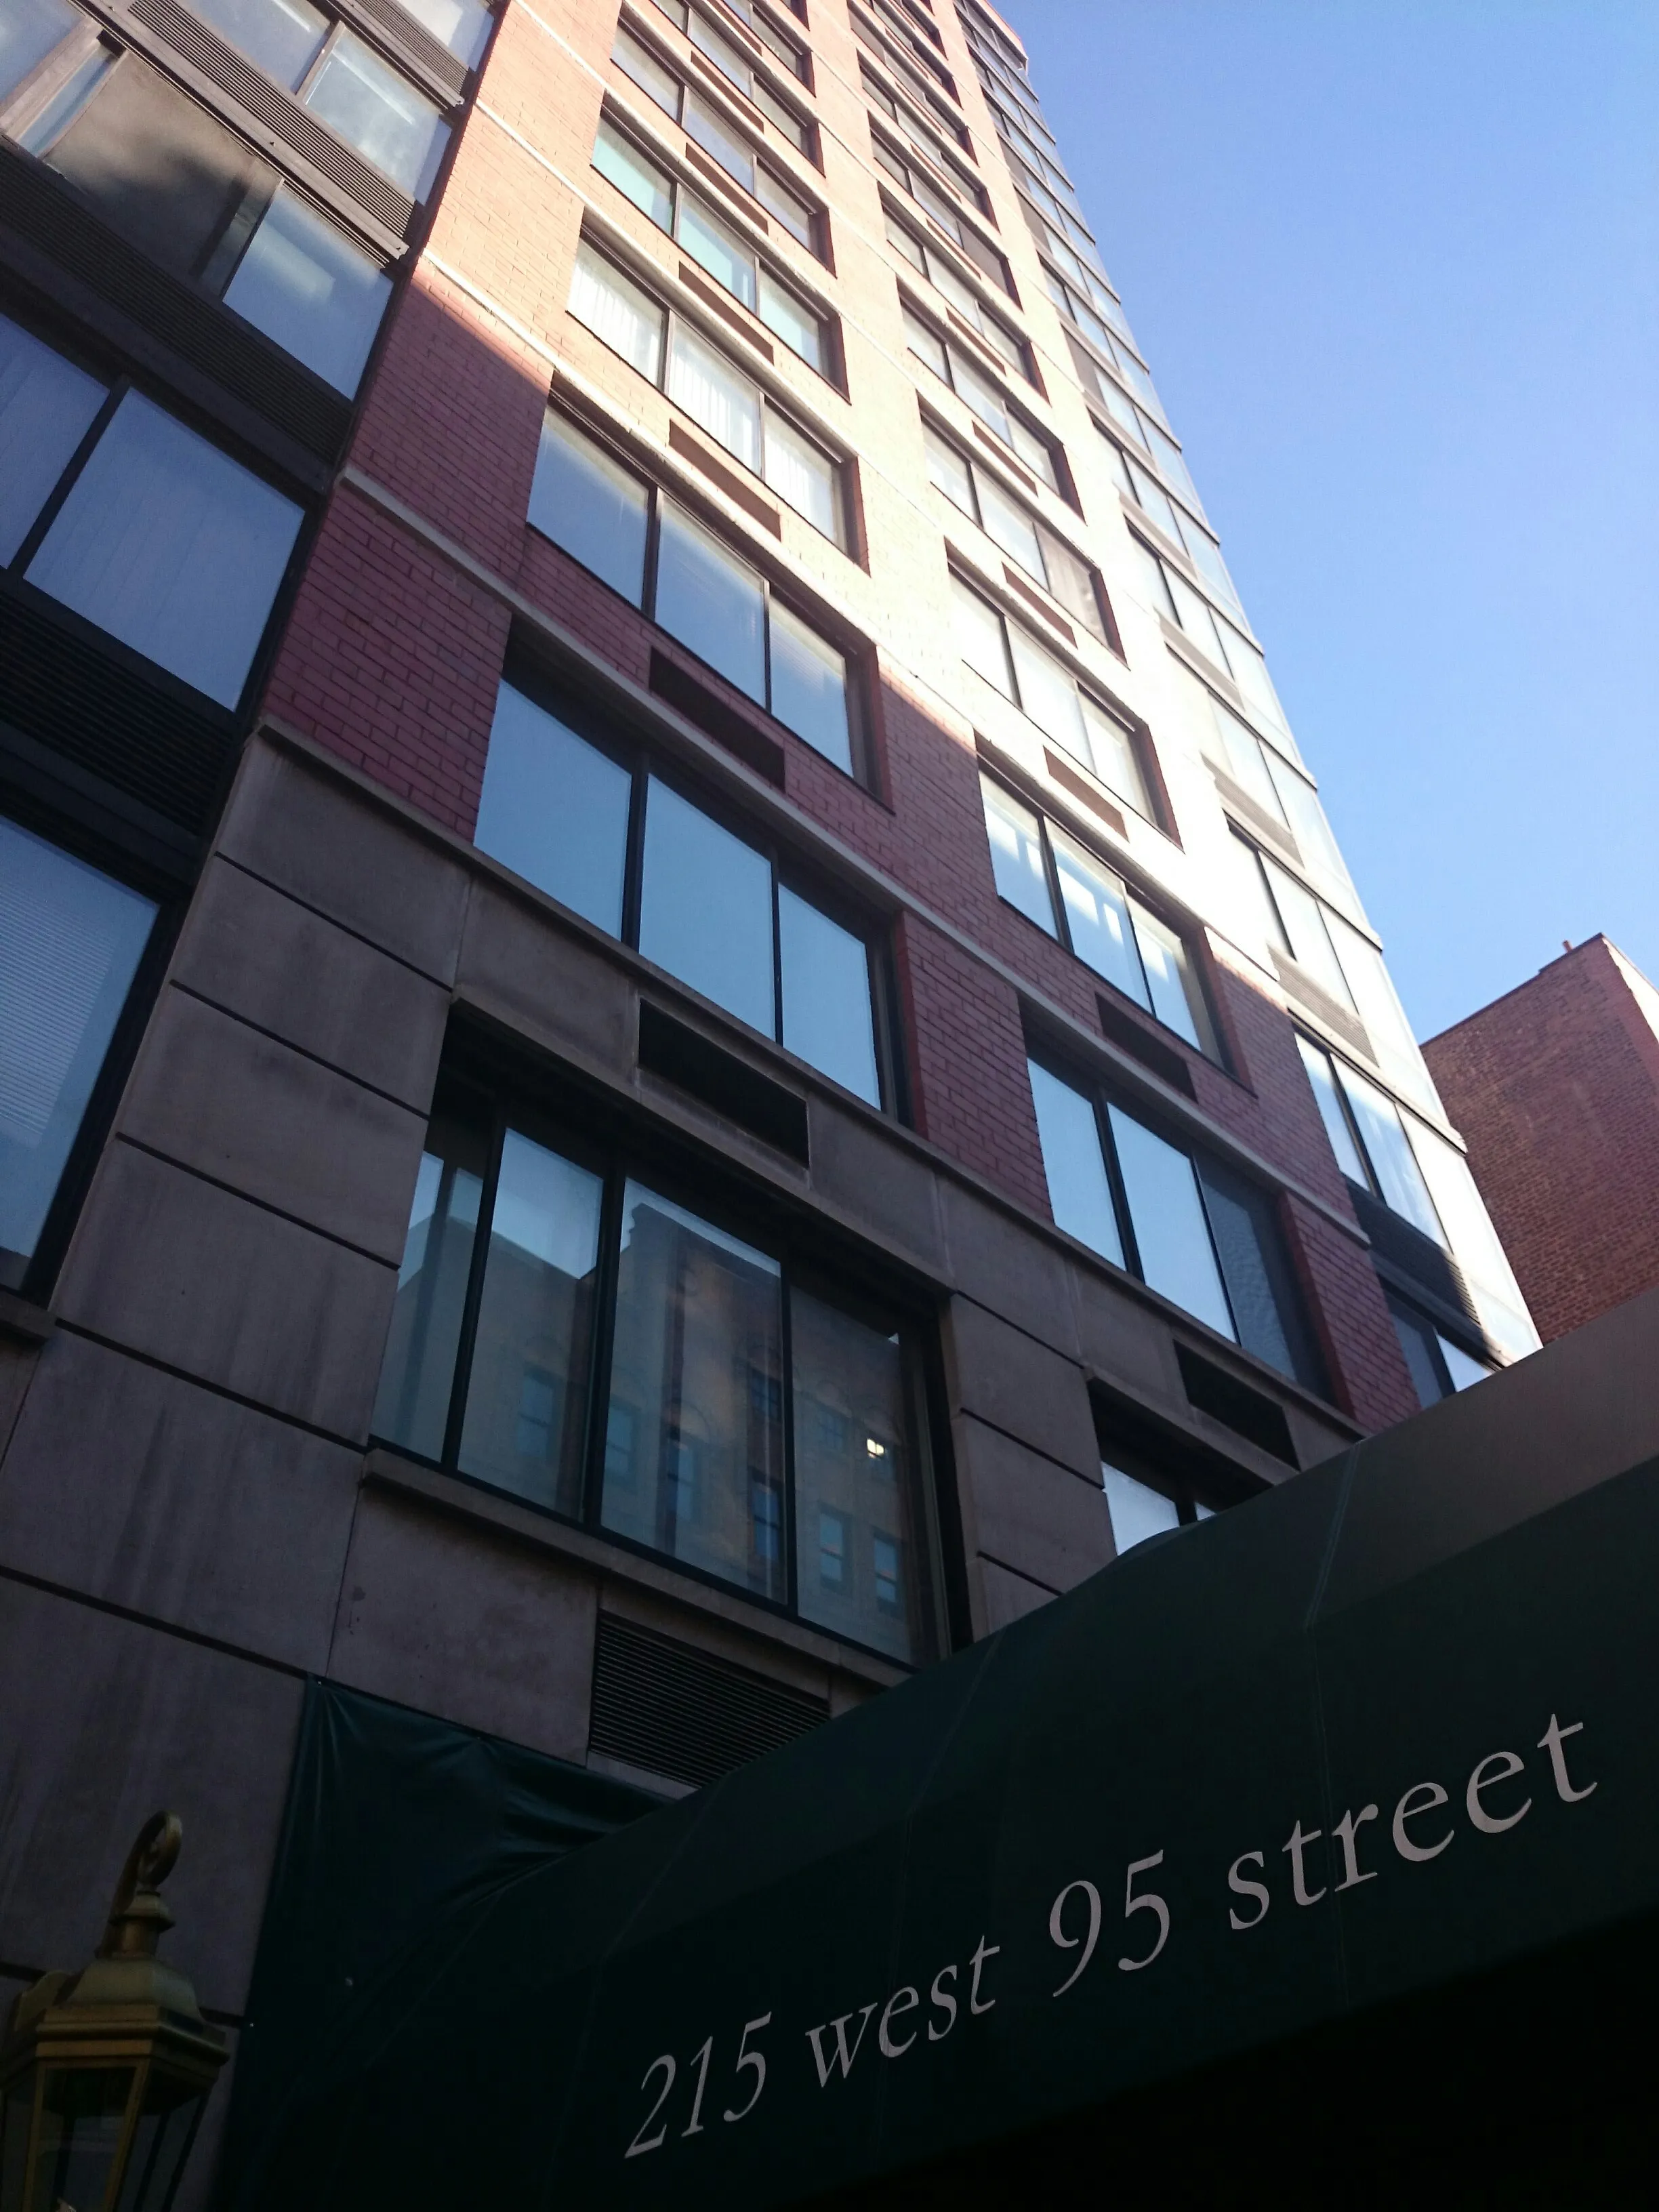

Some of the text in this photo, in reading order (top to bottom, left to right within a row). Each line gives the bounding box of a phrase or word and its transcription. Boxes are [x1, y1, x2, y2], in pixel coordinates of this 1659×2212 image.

[624, 1713, 1598, 2158] 215 west 95 street
